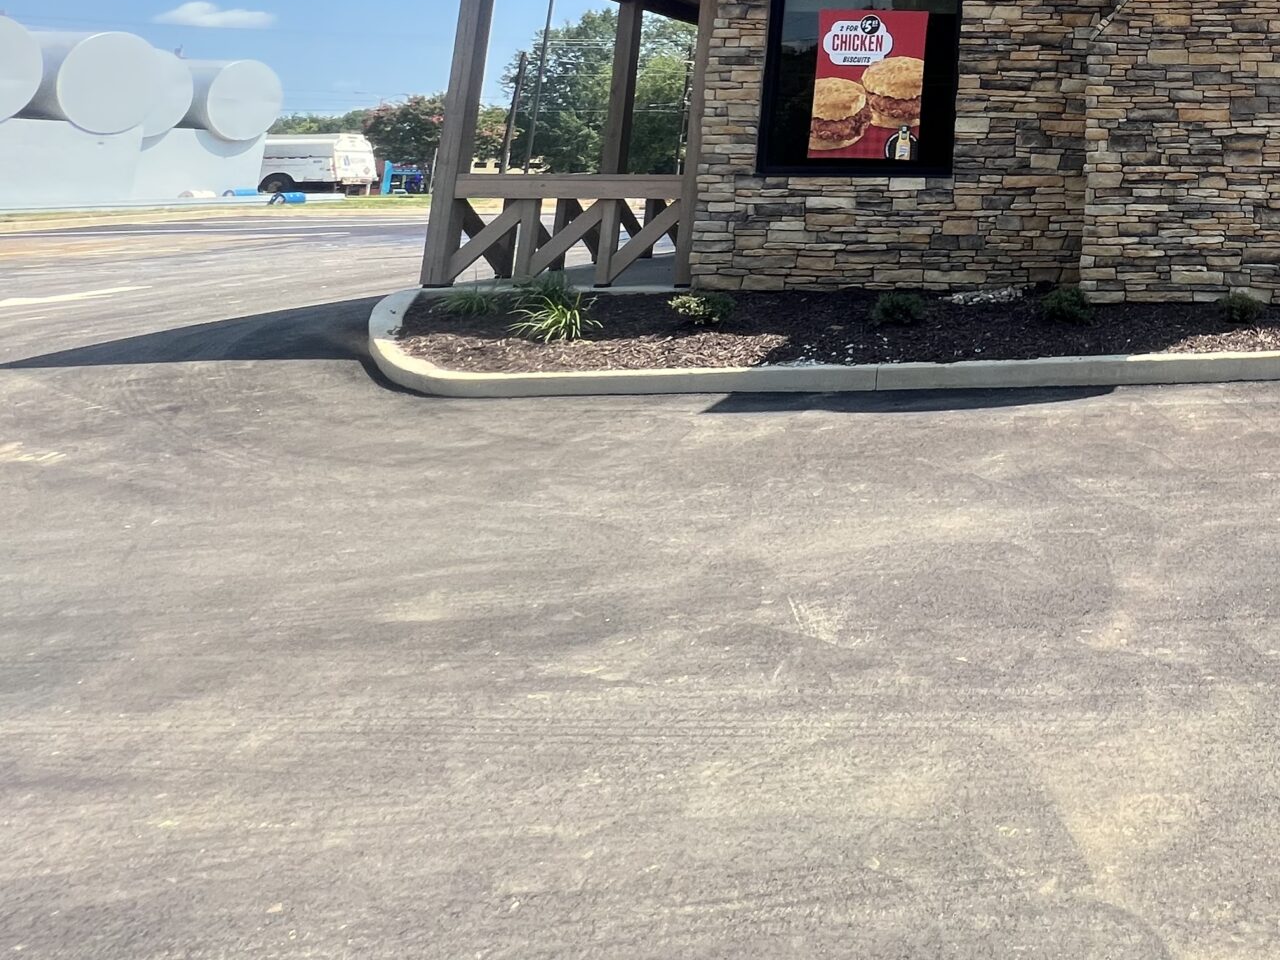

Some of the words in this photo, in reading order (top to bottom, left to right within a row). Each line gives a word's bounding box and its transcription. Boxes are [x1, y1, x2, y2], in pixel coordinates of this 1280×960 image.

[845, 24, 859, 32] FOR
[831, 33, 884, 52] CHICKEN
[842, 55, 872, 64] BISCUITS
